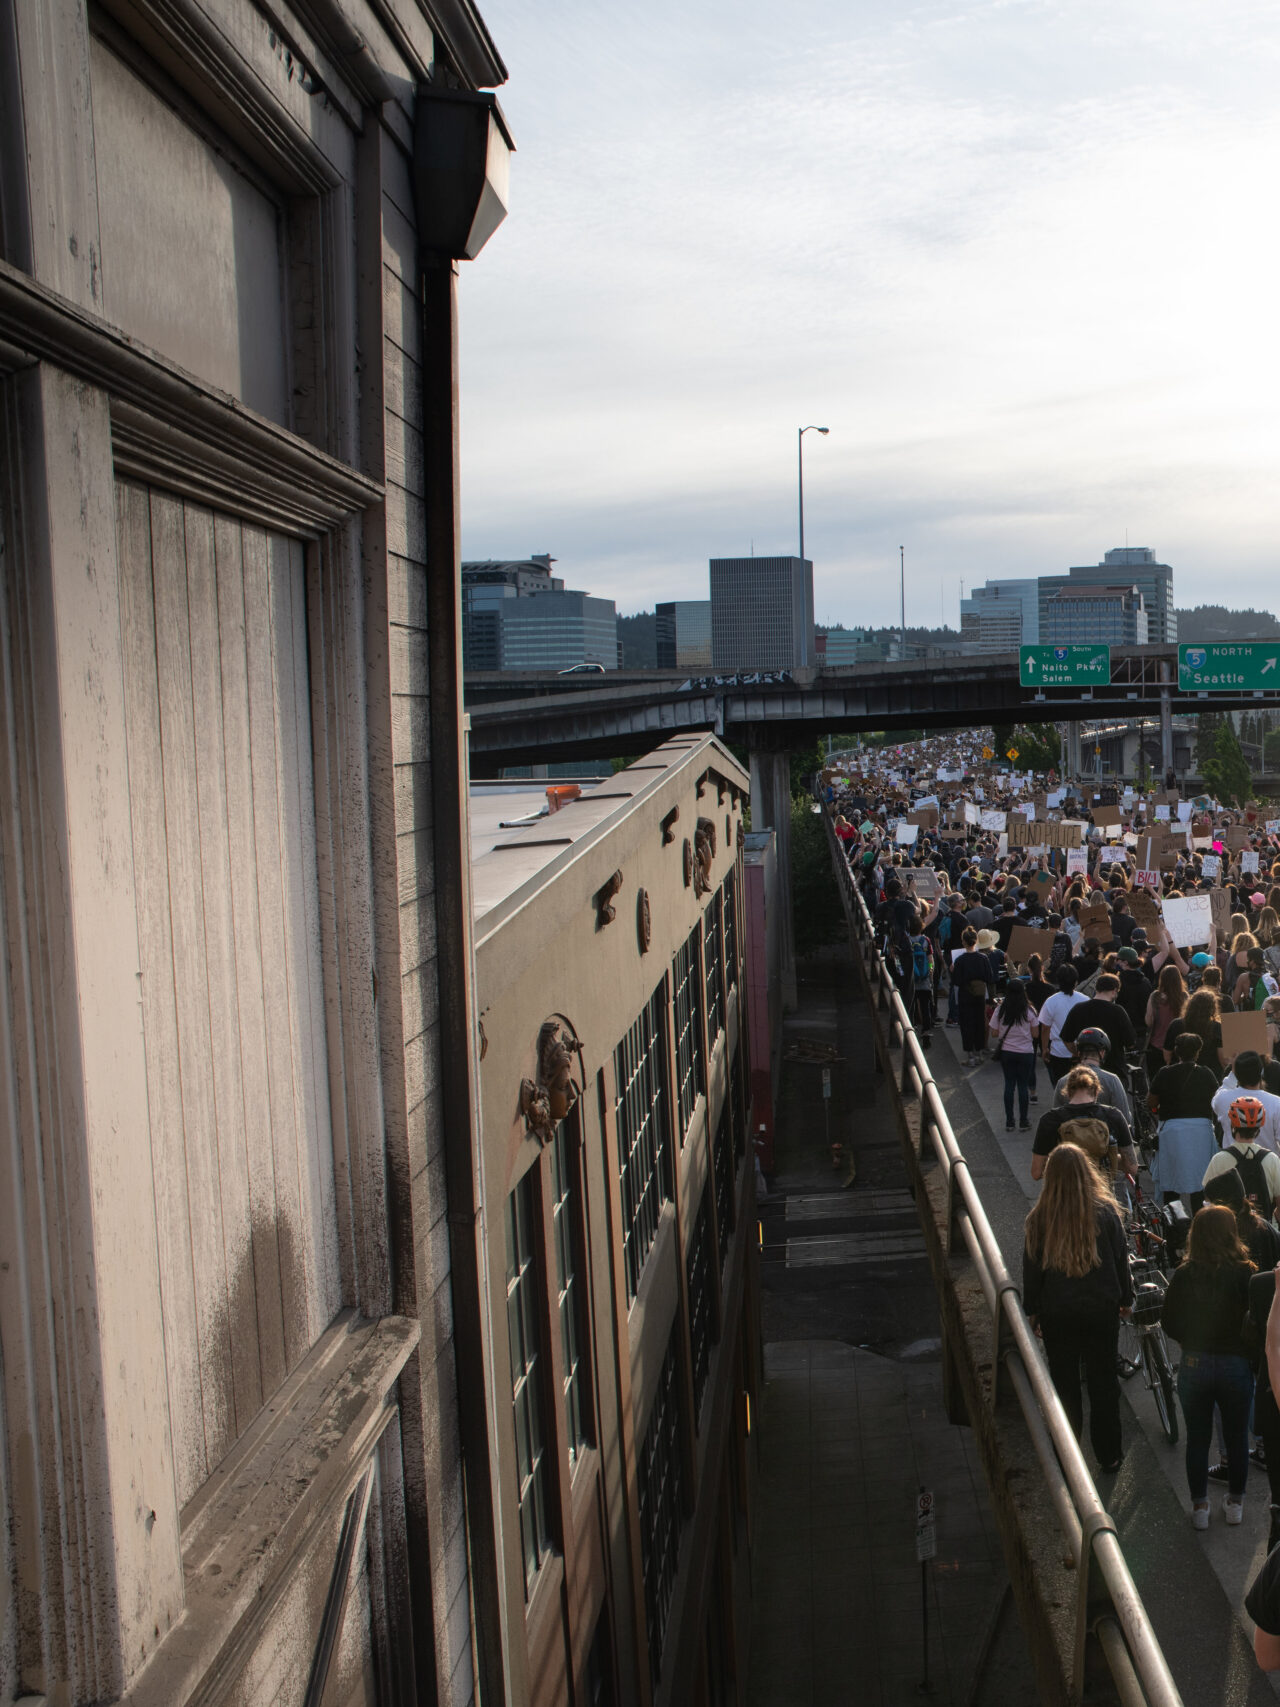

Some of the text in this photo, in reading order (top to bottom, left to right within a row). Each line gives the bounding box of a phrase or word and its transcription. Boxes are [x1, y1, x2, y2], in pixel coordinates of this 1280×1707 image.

[1192, 647, 1252, 665] 5 NORTH
[1042, 663, 1104, 673] Naito Pkwy.
[1042, 674, 1072, 682] Salem
[1194, 673, 1245, 684] Seattle
